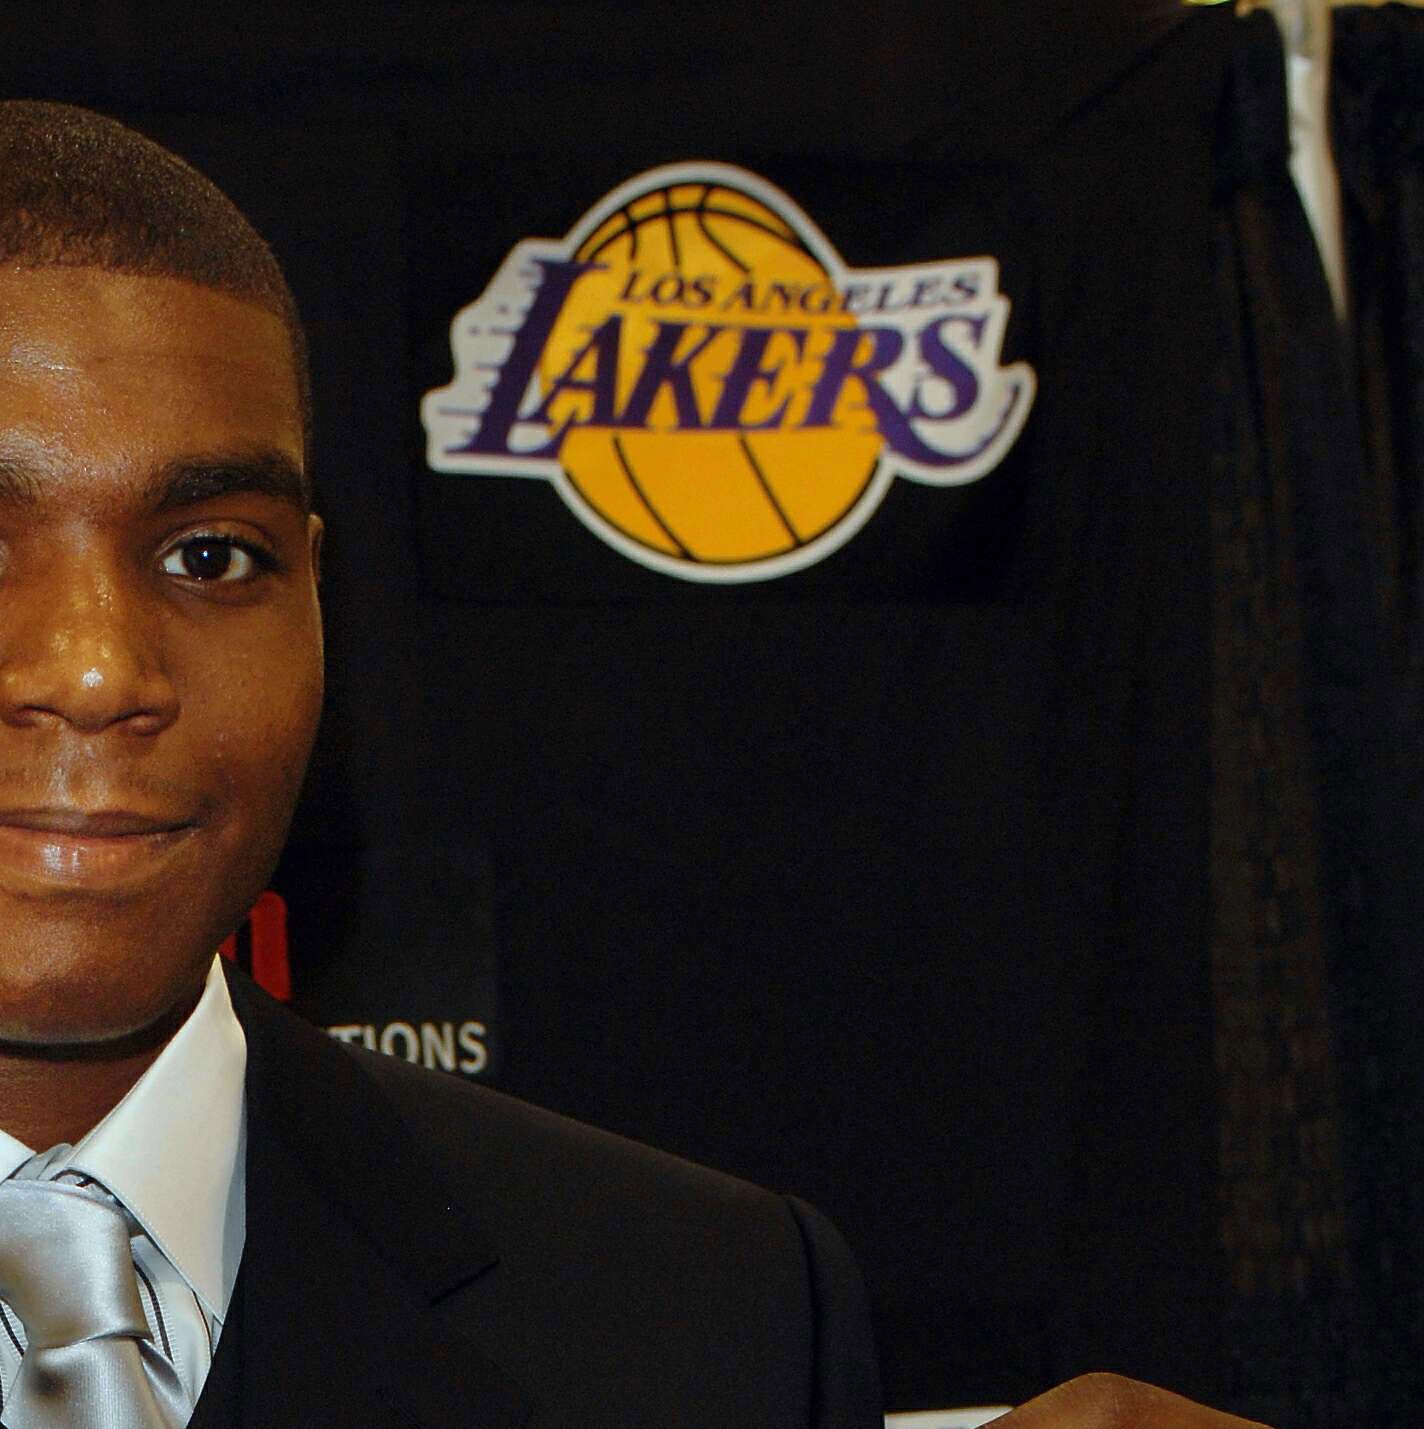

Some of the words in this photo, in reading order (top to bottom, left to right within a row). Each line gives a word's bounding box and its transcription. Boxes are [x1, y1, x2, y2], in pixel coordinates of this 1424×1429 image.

[619, 271, 714, 303] LOS
[721, 271, 976, 314] ANGELES
[440, 258, 1021, 466] LAKERS
